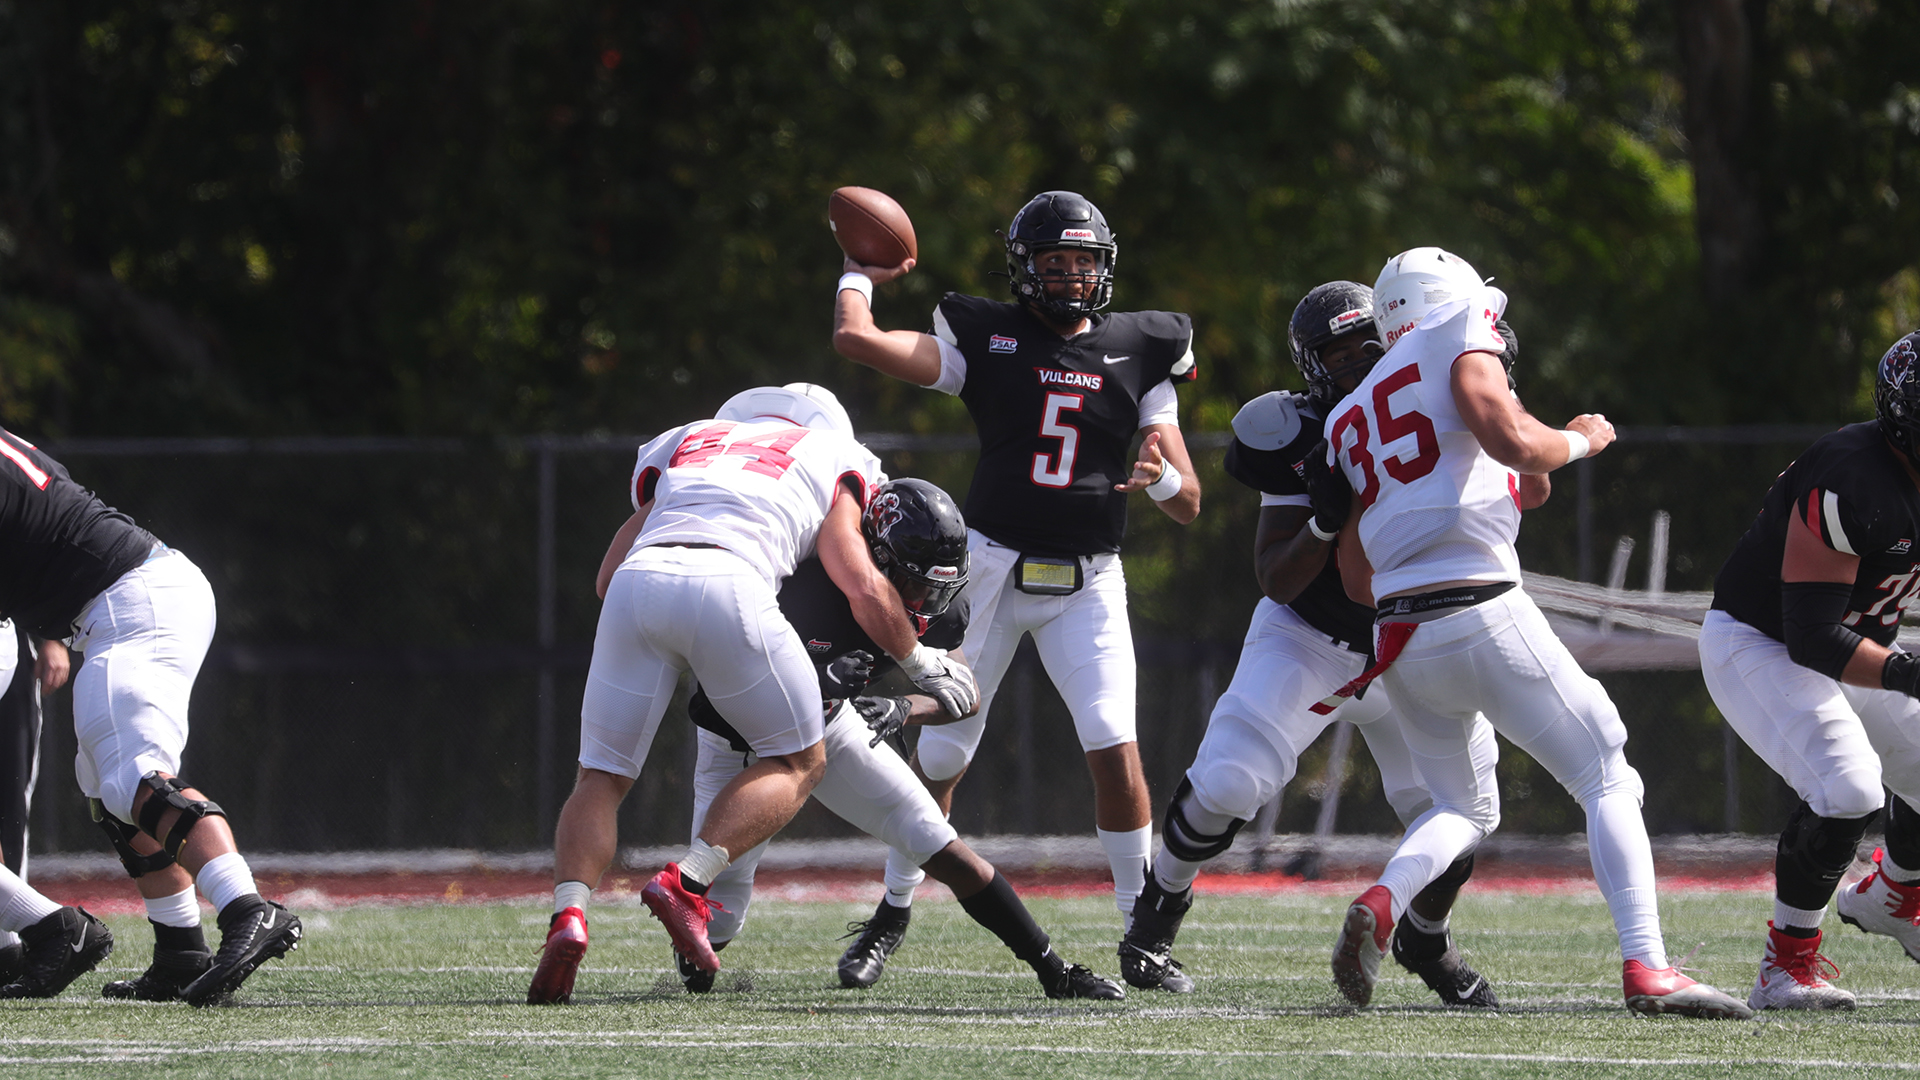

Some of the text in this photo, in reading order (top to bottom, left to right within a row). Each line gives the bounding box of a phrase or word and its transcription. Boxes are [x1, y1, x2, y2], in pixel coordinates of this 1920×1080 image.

[1337, 311, 1360, 323] Riddell
[1388, 300, 1398, 311] 50
[1386, 321, 1415, 344] Ridd
[990, 339, 1017, 350] PSAC
[1037, 368, 1103, 391] VULCANS
[1030, 391, 1084, 489] 5
[1330, 362, 1441, 510] 35
[669, 422, 811, 481] 44
[933, 568, 957, 577] Riddell
